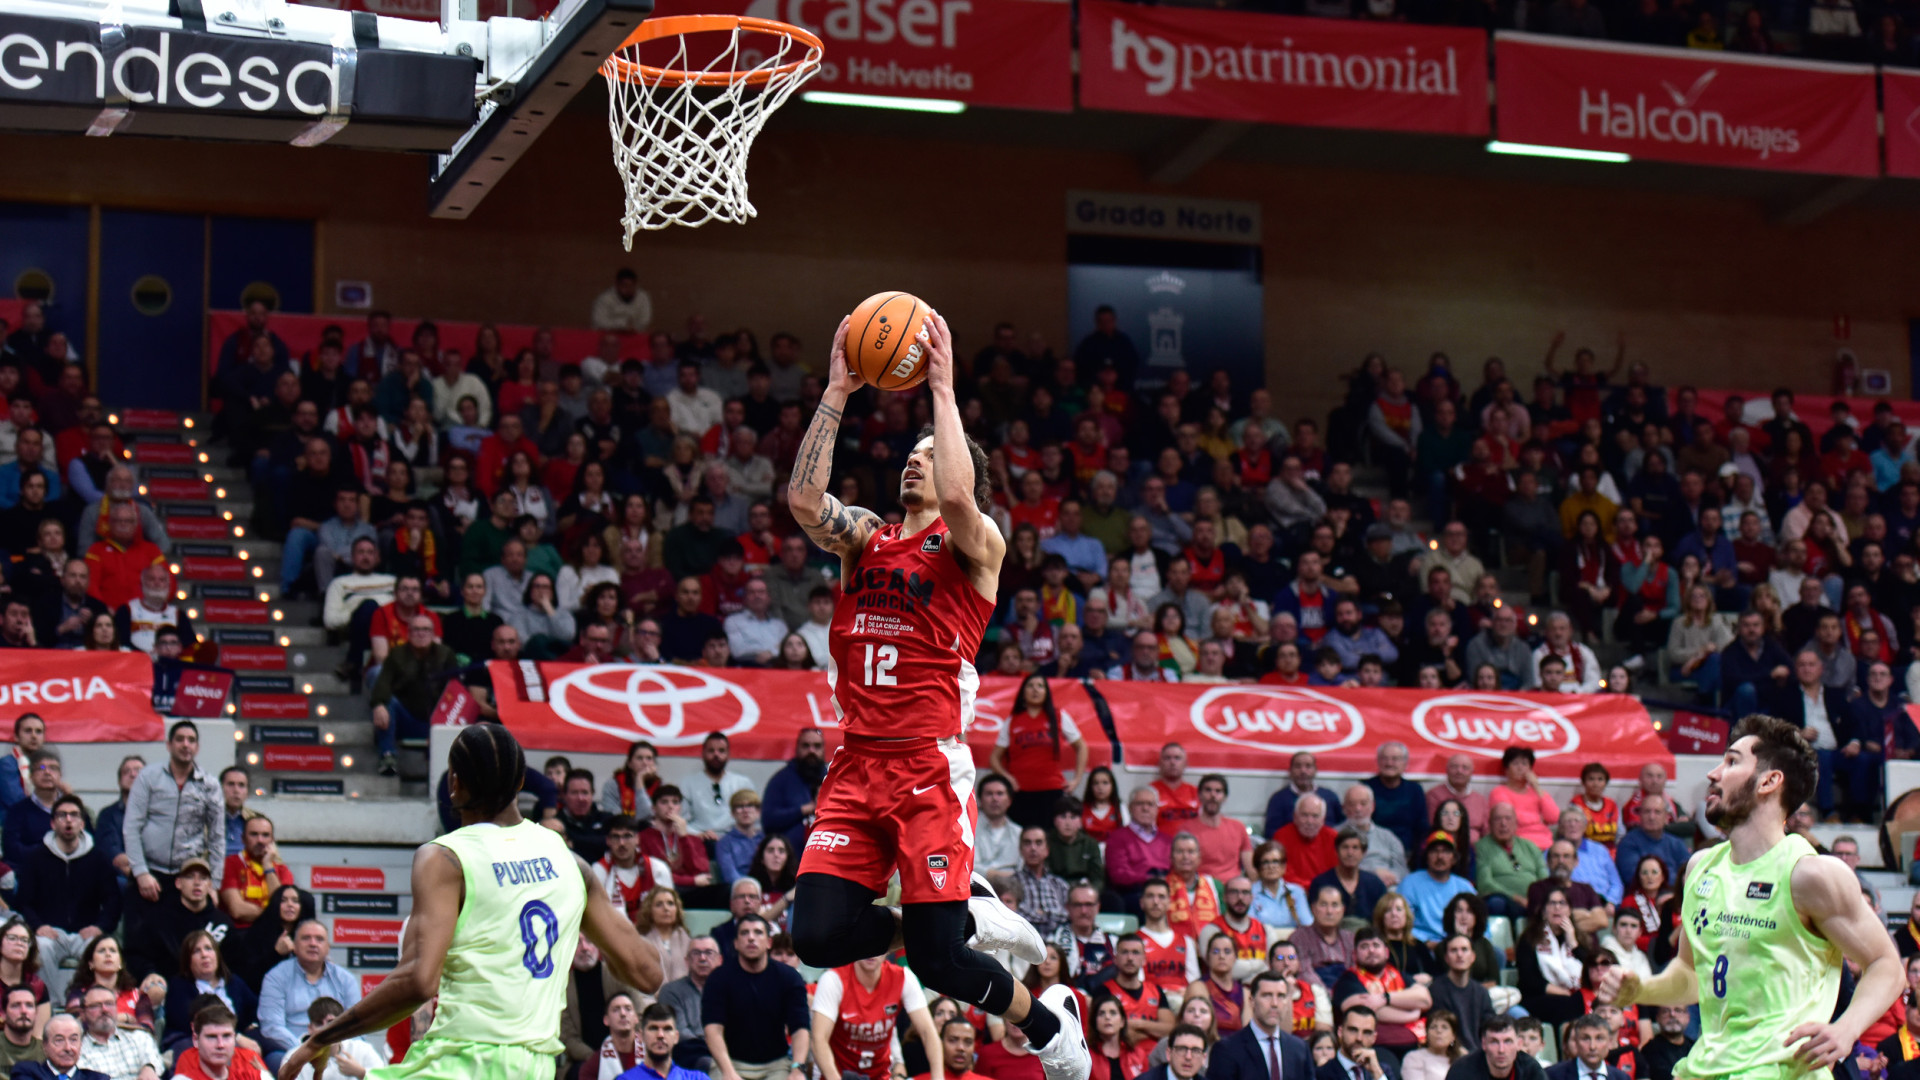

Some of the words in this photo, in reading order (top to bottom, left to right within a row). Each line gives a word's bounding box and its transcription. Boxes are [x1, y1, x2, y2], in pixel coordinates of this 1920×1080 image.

[0, 32, 339, 115] endesa
[848, 57, 973, 91] Helvetia
[1180, 37, 1460, 96] patrimonial
[1075, 199, 1166, 227] Grada
[1177, 207, 1253, 233] Norte
[874, 324, 892, 350] acb
[856, 593, 916, 614] MURCIA
[868, 614, 901, 623] CARAVACA
[899, 624, 914, 632] 2024
[864, 643, 899, 686] 12
[1215, 704, 1342, 733] Juver
[1437, 711, 1557, 742] Juver
[492, 857, 559, 888] PUNTER
[930, 857, 944, 867] acb
[1717, 911, 1777, 929] Assistència
[519, 899, 559, 980] 0
[1713, 954, 1729, 999] 8
